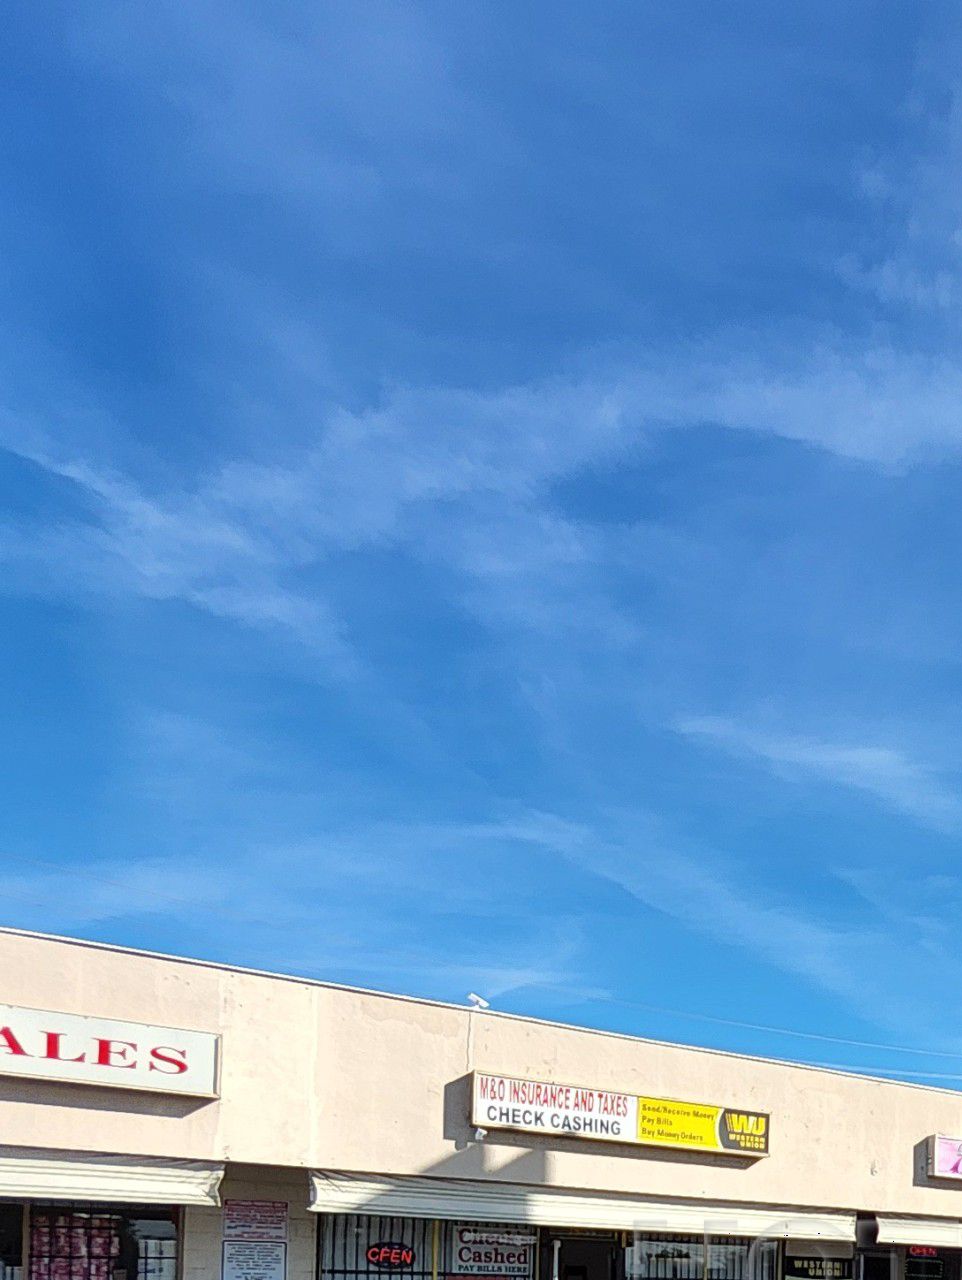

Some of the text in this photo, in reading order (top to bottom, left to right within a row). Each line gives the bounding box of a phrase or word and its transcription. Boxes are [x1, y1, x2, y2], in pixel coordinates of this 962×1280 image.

[480, 1077, 629, 1118] M&O INSURANCE AND TAXES
[487, 1105, 622, 1136] CHECK CASHING
[641, 1116, 673, 1126] Pay Bills
[641, 1127, 704, 1141] Buy Money Orders
[740, 1141, 765, 1150] UNION
[458, 1246, 529, 1265] Cashed
[458, 1264, 528, 1274] PAY BILLS HERE
[794, 1260, 841, 1268] WESTERN
[808, 1268, 841, 1277] UNION
